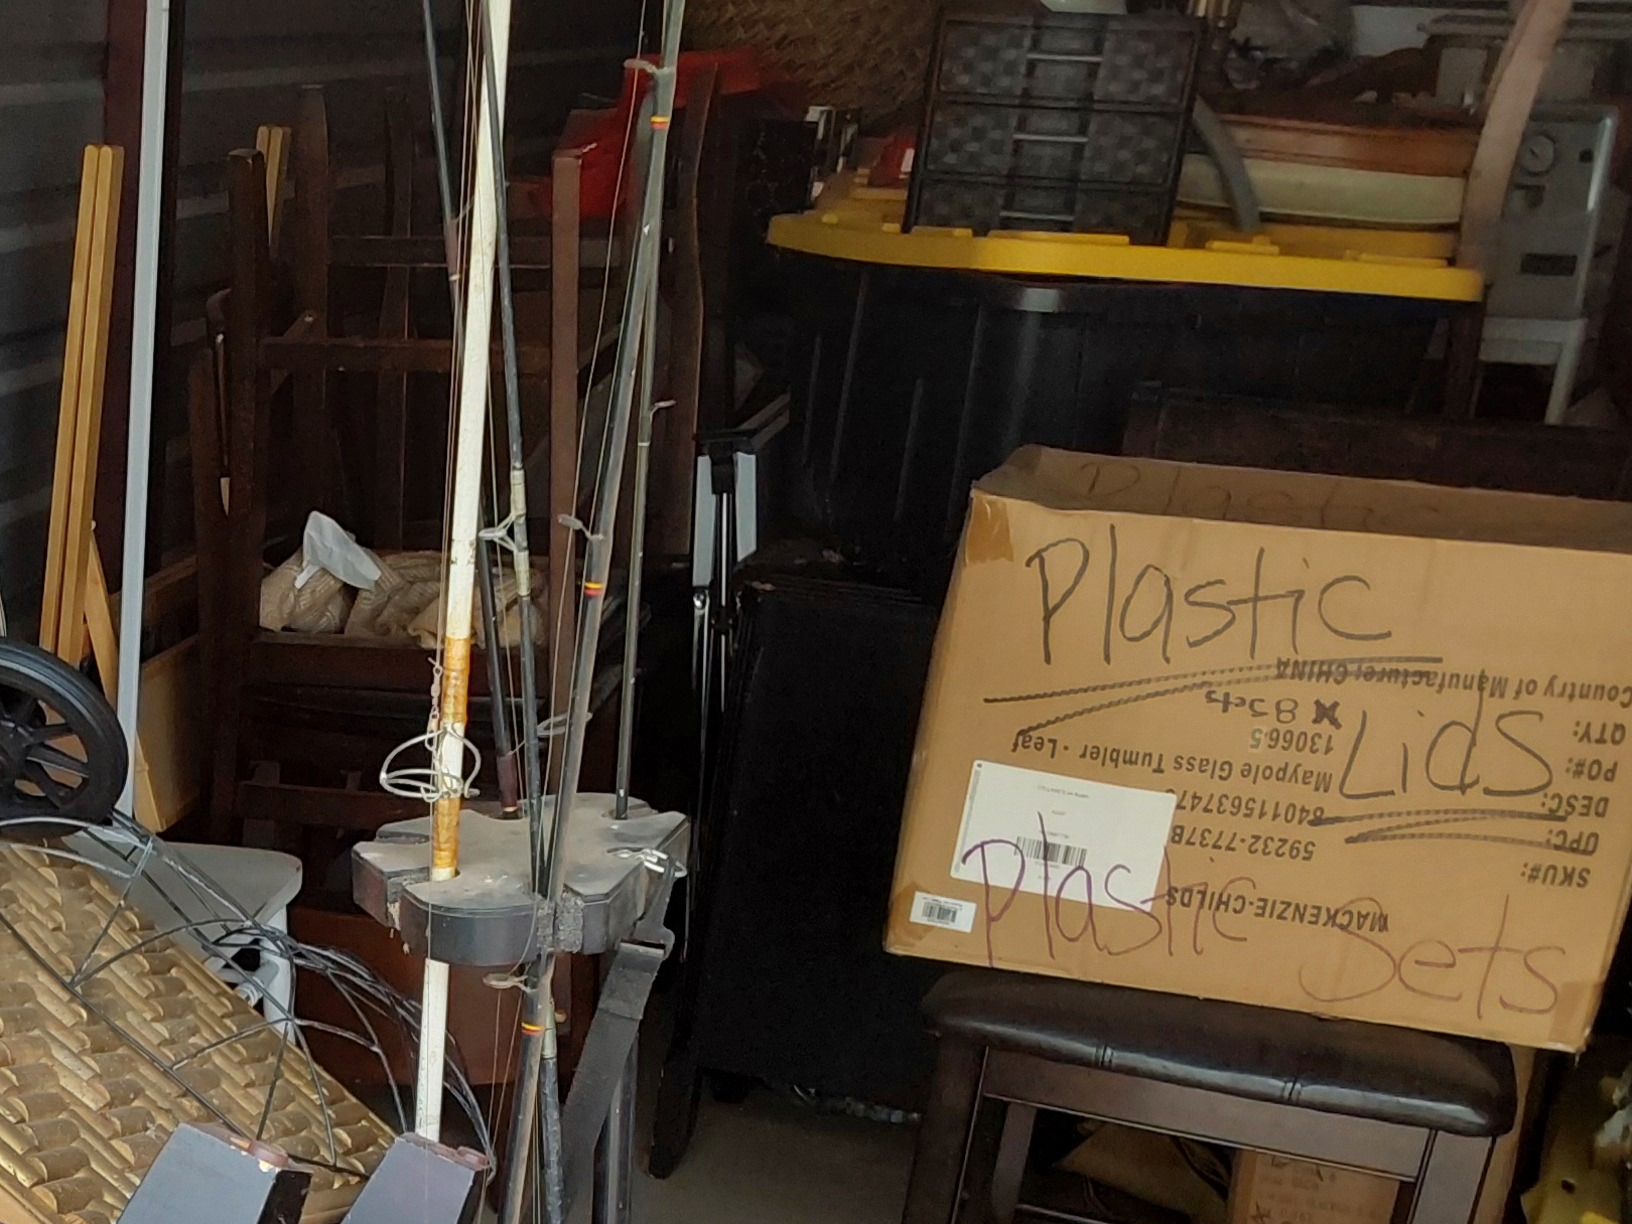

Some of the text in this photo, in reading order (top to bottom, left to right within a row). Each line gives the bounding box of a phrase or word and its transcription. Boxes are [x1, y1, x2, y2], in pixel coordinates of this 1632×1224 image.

[1024, 523, 1393, 666] Plastic
[1275, 657, 1348, 686] CHINA
[1515, 676, 1540, 697] of
[1544, 675, 1632, 709] Country
[1010, 730, 1058, 760] Leaf
[1571, 720, 1626, 746] QTY:
[1079, 743, 1165, 774] Tumbler
[1172, 754, 1233, 780] Glass
[1565, 757, 1618, 783] PO#:
[1239, 762, 1334, 794] Maypole
[1541, 792, 1610, 819] DESC:
[1170, 825, 1317, 861] 59232-7737B
[1547, 829, 1600, 857] UPC:
[961, 810, 1257, 968] Plastic
[1521, 862, 1591, 890] SKU#:
[1165, 886, 1390, 933] MACKENZIE-CHILDS
[1298, 893, 1567, 1020] Sets
